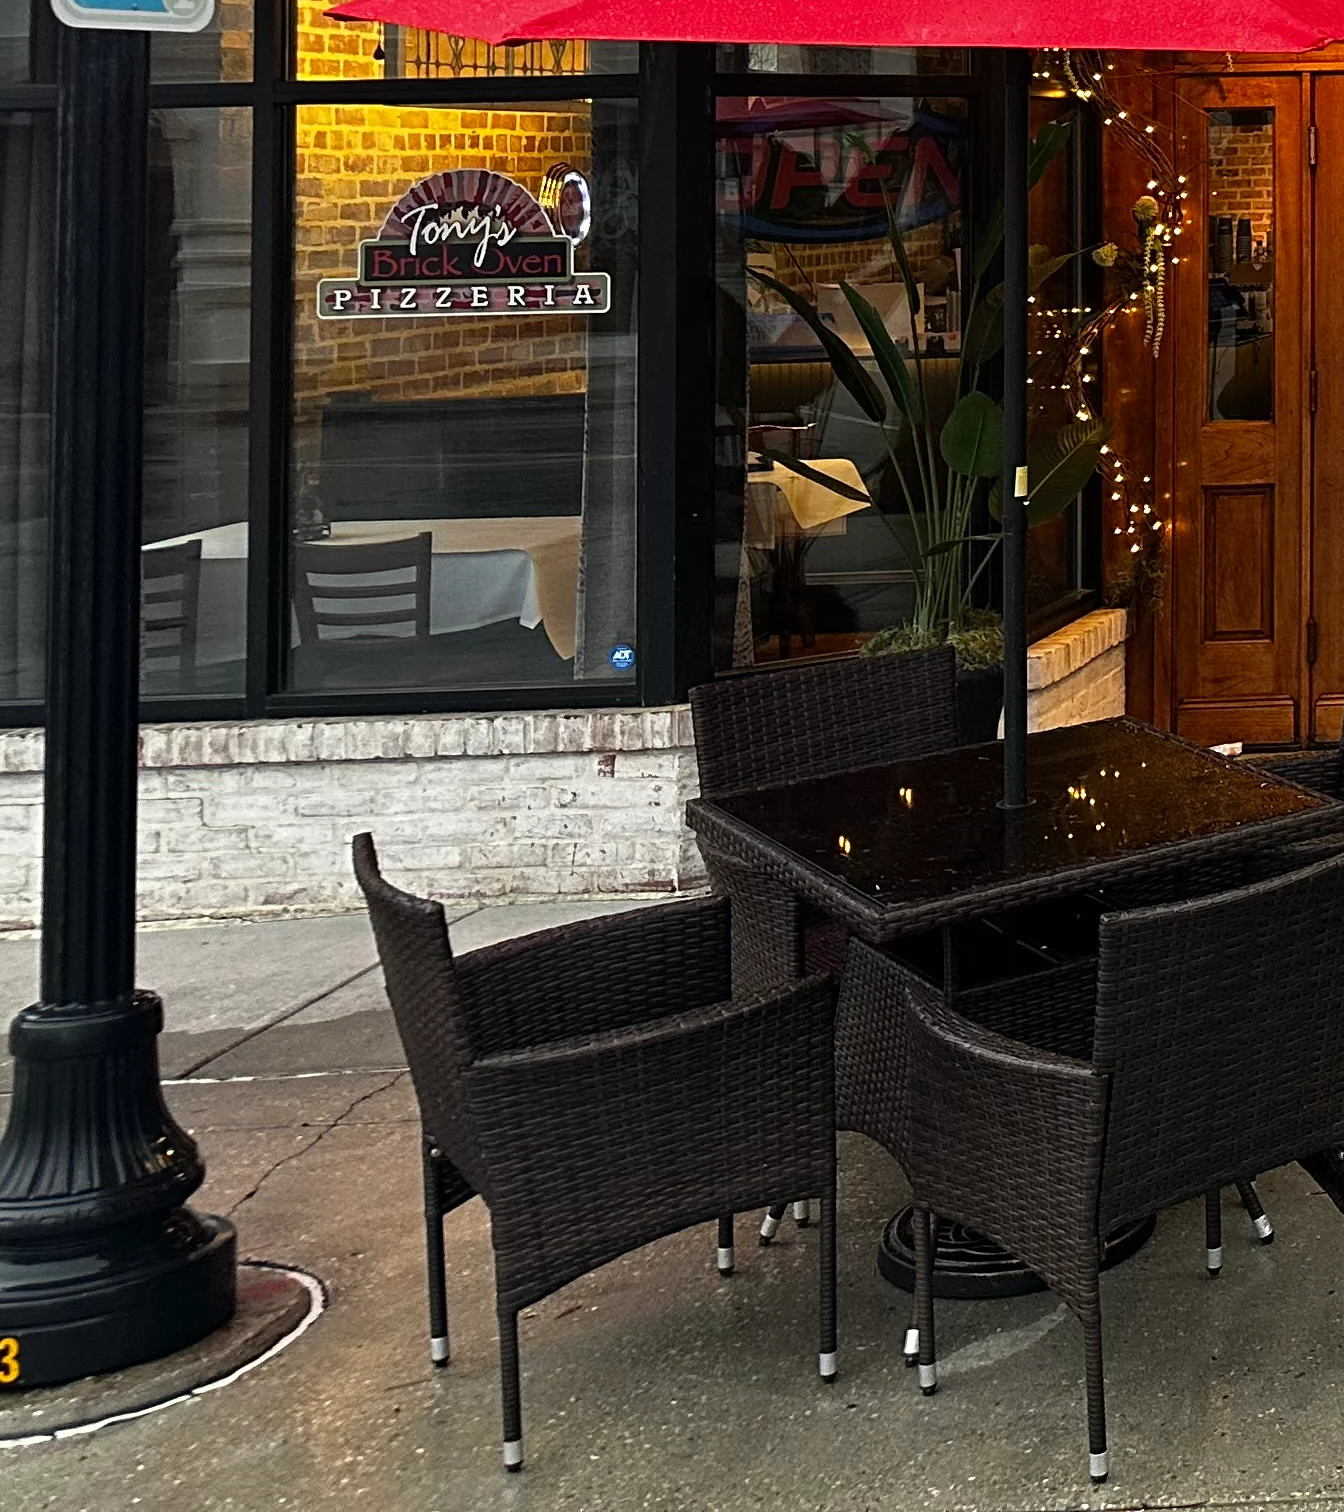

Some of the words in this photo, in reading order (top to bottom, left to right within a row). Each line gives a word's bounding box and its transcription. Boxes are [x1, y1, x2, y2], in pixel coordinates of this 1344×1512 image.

[401, 203, 517, 268] Tony's
[371, 244, 462, 279] Brick
[470, 247, 562, 276] Oven
[333, 284, 595, 311] PIZZERIA
[612, 649, 633, 661] ADT
